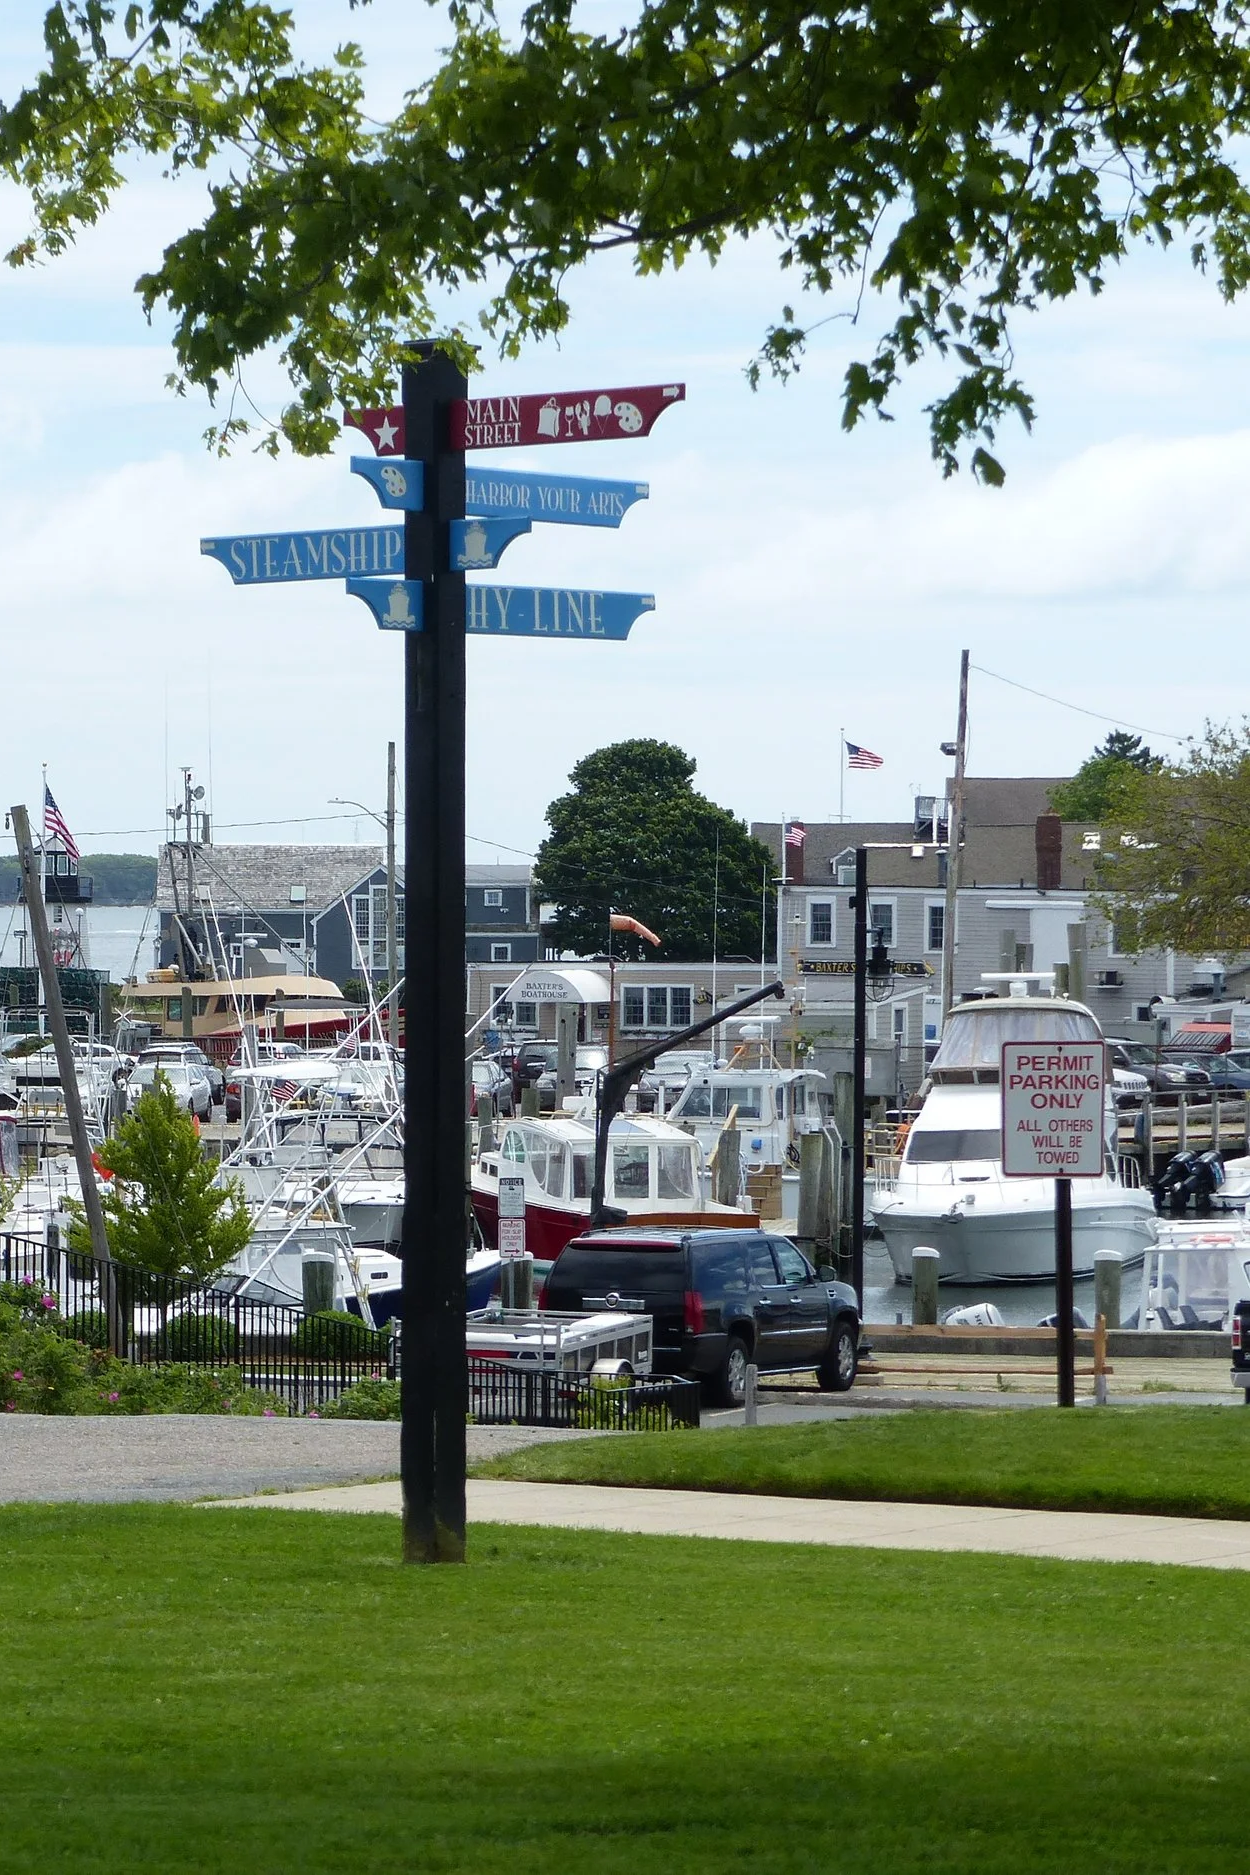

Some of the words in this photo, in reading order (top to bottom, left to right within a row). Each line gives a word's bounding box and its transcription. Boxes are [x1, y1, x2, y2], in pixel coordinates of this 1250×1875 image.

[464, 397, 521, 424] MAIN
[464, 422, 521, 446] STREET
[466, 480, 530, 509] HARBOR
[538, 486, 580, 513] YOUR
[587, 491, 625, 516] ARTS
[230, 529, 402, 580] STEAMSHIP
[1017, 1055, 1094, 1071] PERMIT
[1009, 1074, 1099, 1090] PARKING
[1030, 1093, 1083, 1109] ONLY
[1017, 1119, 1042, 1132] ALL
[1048, 1119, 1093, 1132] OTHERS
[1032, 1135, 1064, 1148] WILL
[1069, 1135, 1082, 1148] BE
[1036, 1151, 1079, 1164] TOWED
